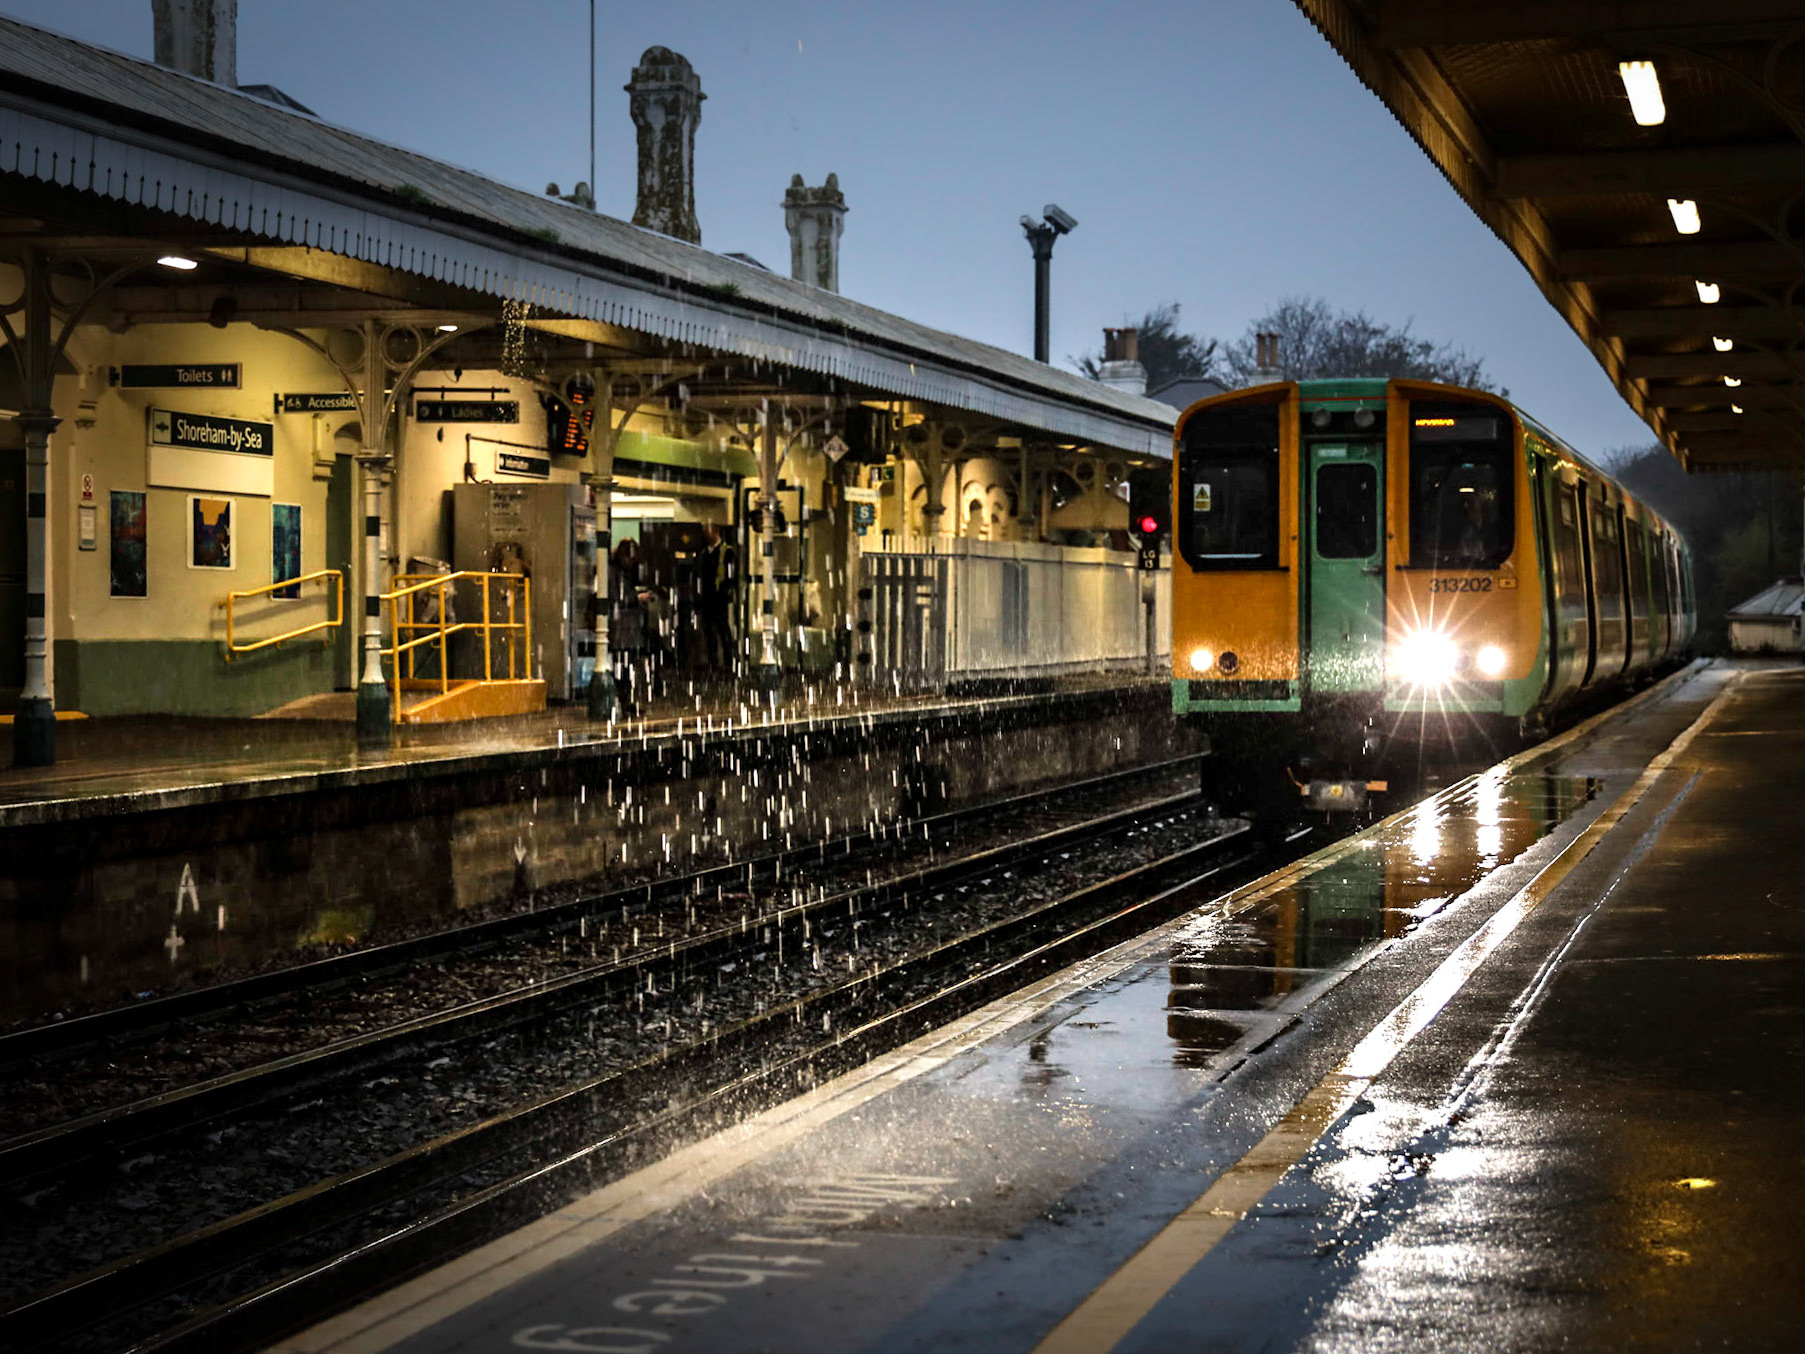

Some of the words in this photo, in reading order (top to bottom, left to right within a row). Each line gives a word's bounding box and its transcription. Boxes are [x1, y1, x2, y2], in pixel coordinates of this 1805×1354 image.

[176, 368, 214, 383] Toilets
[176, 418, 263, 452] Shoreham-by-Sea
[859, 505, 870, 519] S
[1142, 549, 1156, 559] LG
[1429, 577, 1492, 593] 313202
[612, 1253, 826, 1316] the
